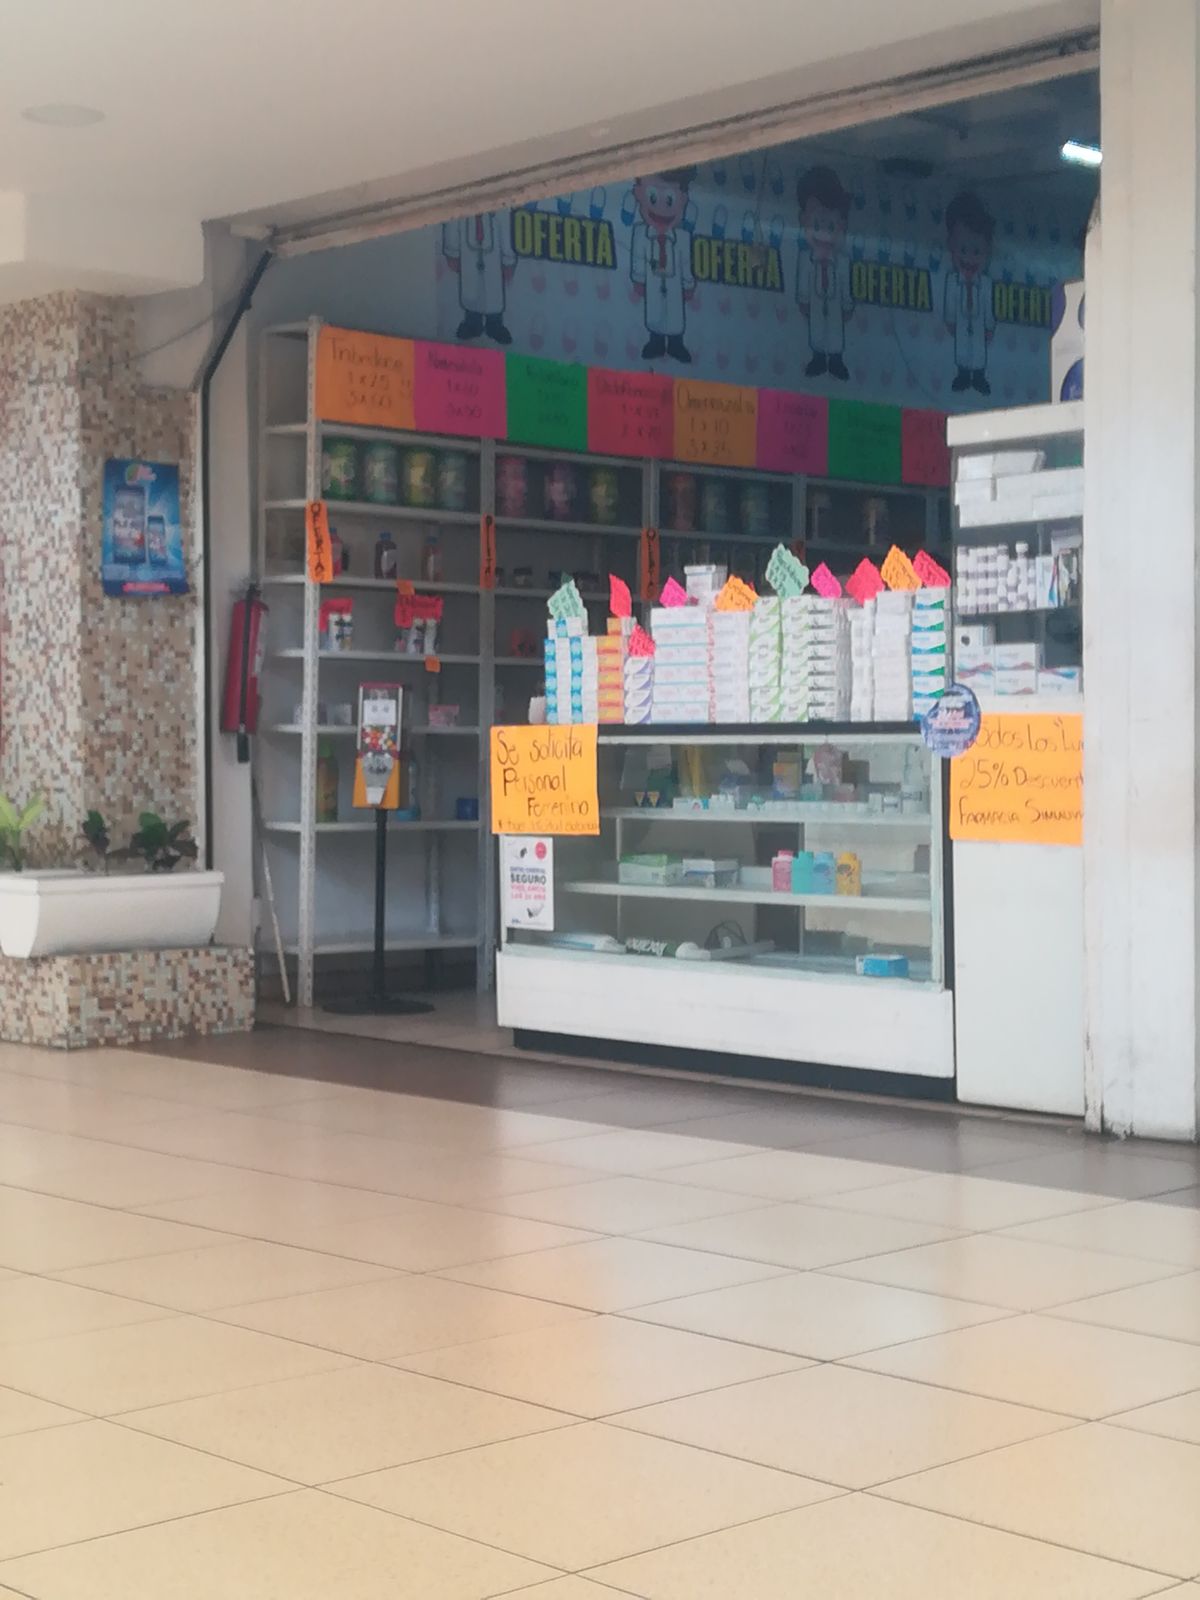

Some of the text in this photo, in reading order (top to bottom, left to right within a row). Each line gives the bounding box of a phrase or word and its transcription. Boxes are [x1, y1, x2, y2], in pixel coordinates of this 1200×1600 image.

[514, 210, 613, 267] OFERTA
[693, 238, 782, 289] OFERTA
[852, 261, 930, 309] OFERTA
[496, 730, 520, 765] Se
[975, 717, 1024, 751] odos
[503, 765, 567, 797] Personal
[959, 756, 1009, 790] 25%
[510, 872, 547, 886] SEGURO
